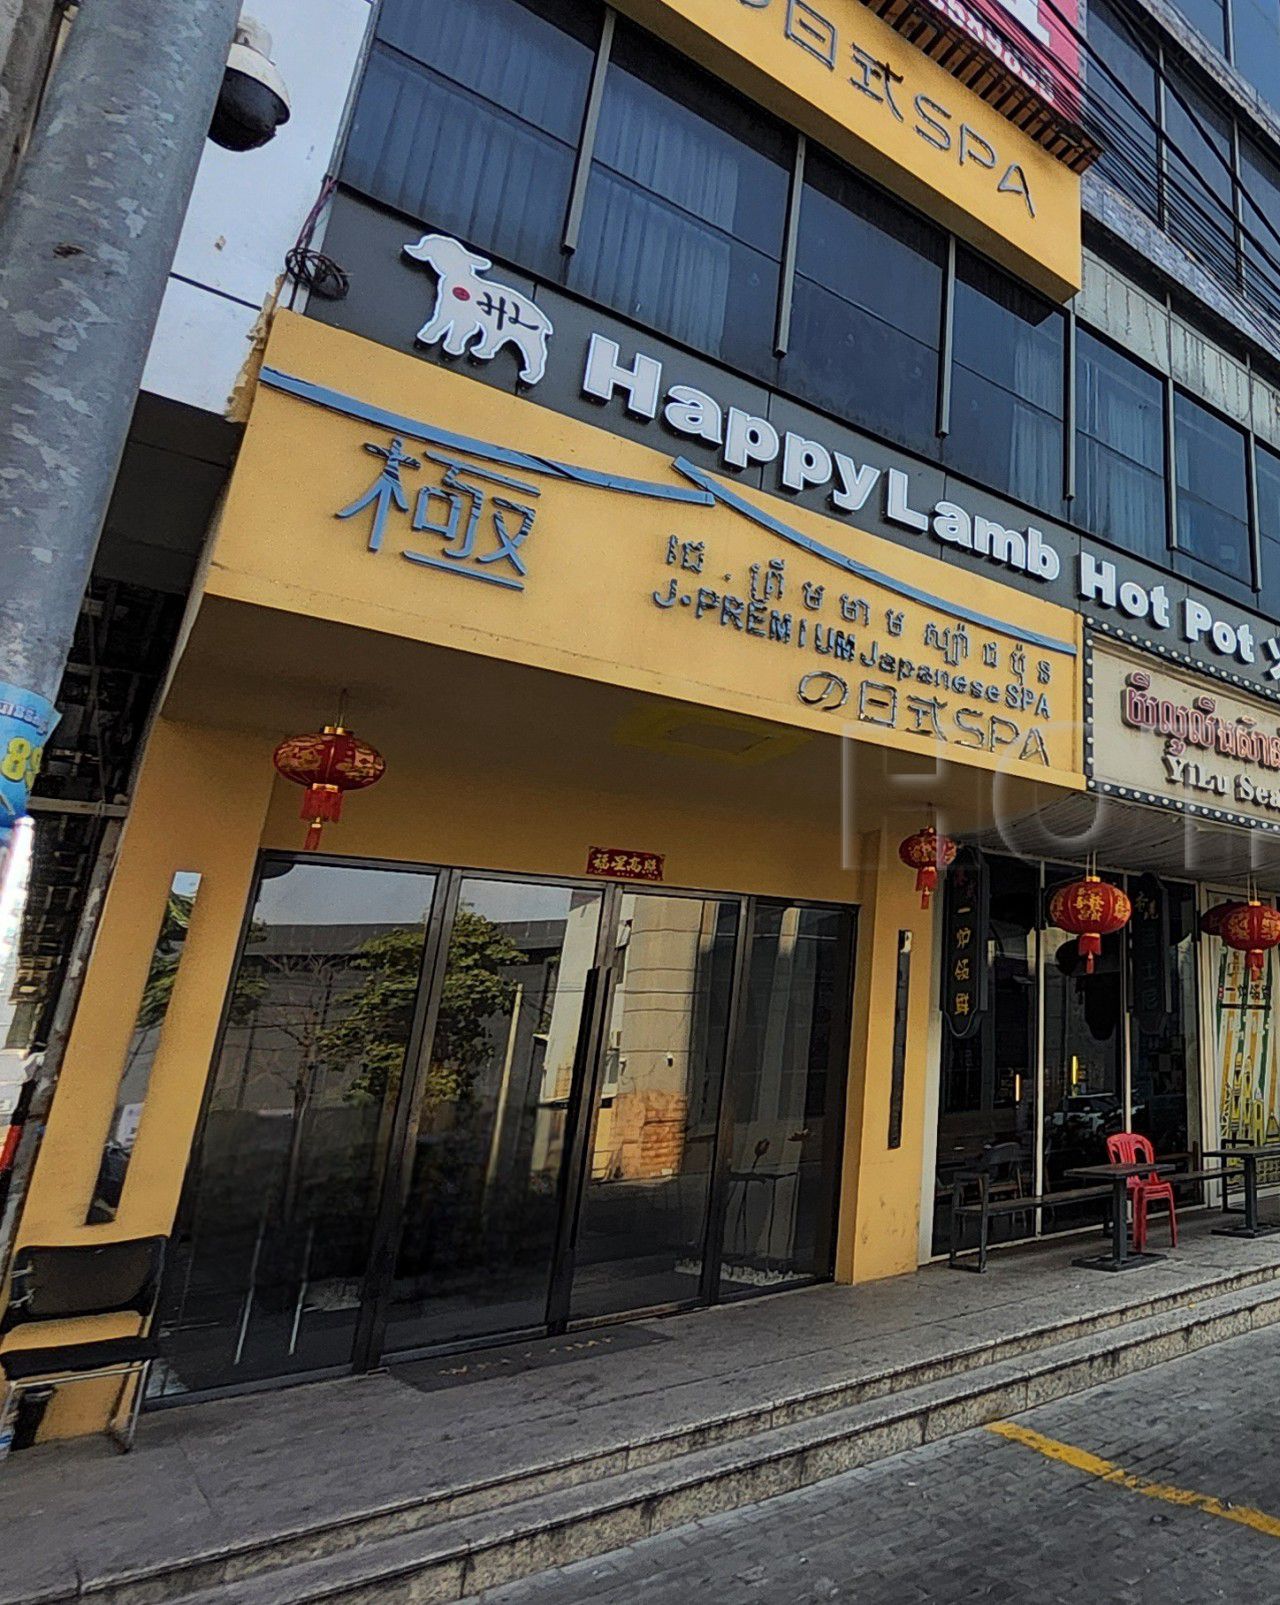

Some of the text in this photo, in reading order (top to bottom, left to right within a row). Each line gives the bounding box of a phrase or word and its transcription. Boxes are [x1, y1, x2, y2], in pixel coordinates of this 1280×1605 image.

[740, 0, 1036, 218] 日式SPA
[336, 438, 542, 591] 極
[1078, 551, 1171, 630] Hot
[1184, 598, 1255, 664] Pot
[859, 641, 1000, 704] Japanese
[1004, 684, 1051, 720] SPA
[1167, 753, 1231, 794] YiLu
